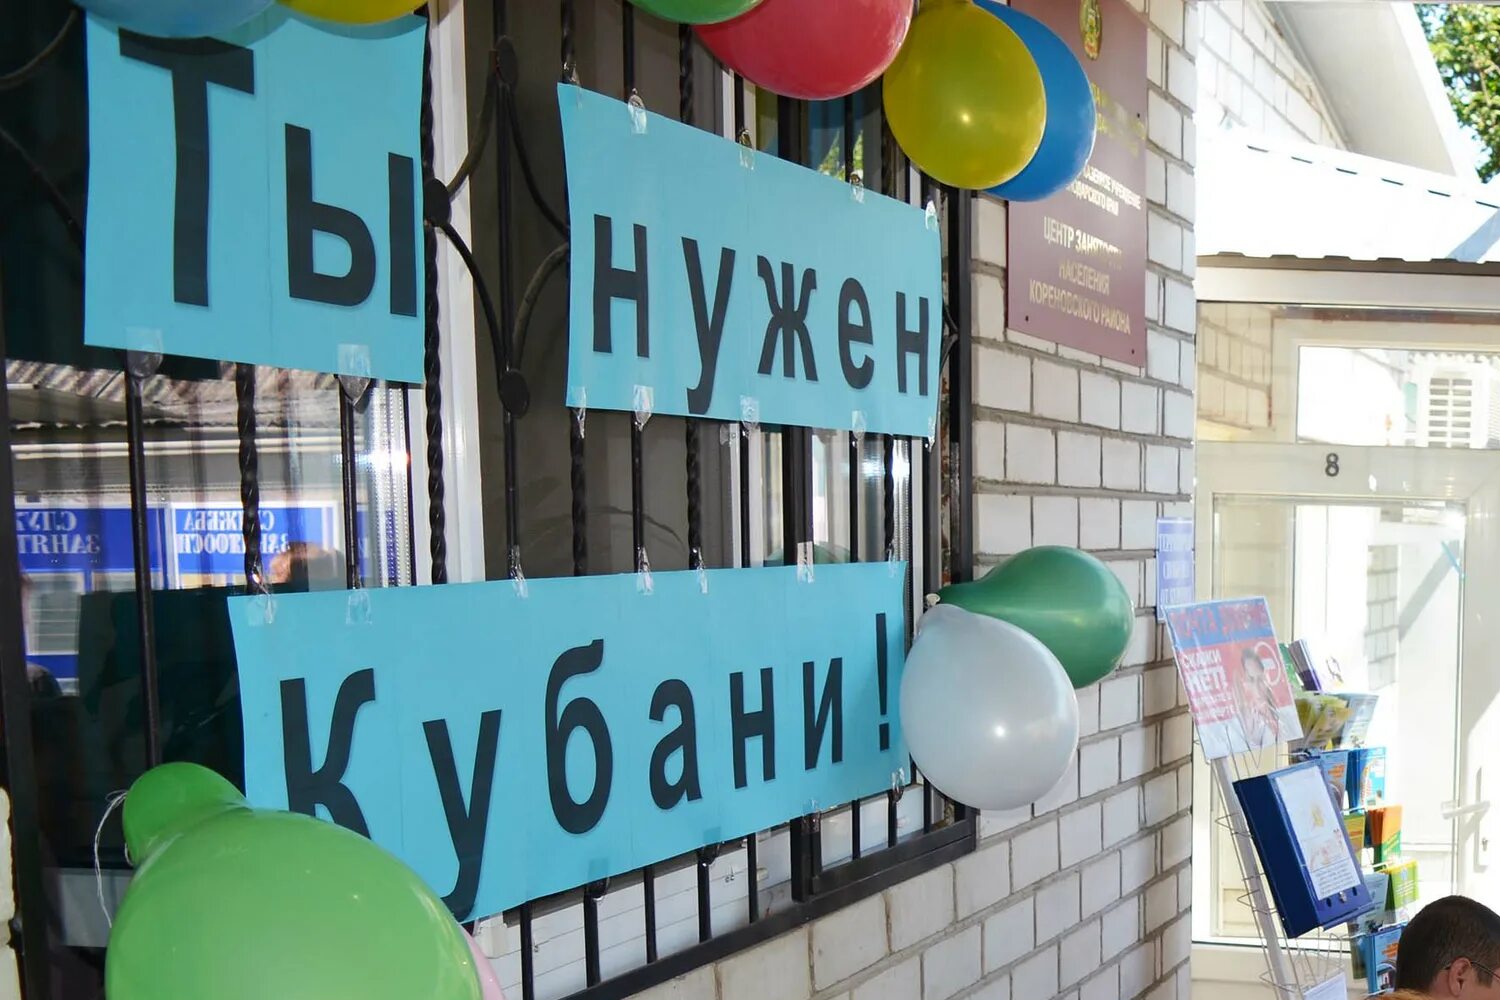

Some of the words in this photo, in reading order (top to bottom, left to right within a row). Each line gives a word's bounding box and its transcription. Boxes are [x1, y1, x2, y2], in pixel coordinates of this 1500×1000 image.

[118, 29, 417, 317] Ты
[1043, 216, 1074, 249] ЦЕНТР
[1058, 259, 1110, 296] НАСЕЛЕНИЯ
[592, 214, 931, 414] нужен
[1029, 279, 1100, 323] КОРЕНОВСКОГО
[1325, 452, 1339, 477] 8
[279, 612, 890, 922] Кубани!
